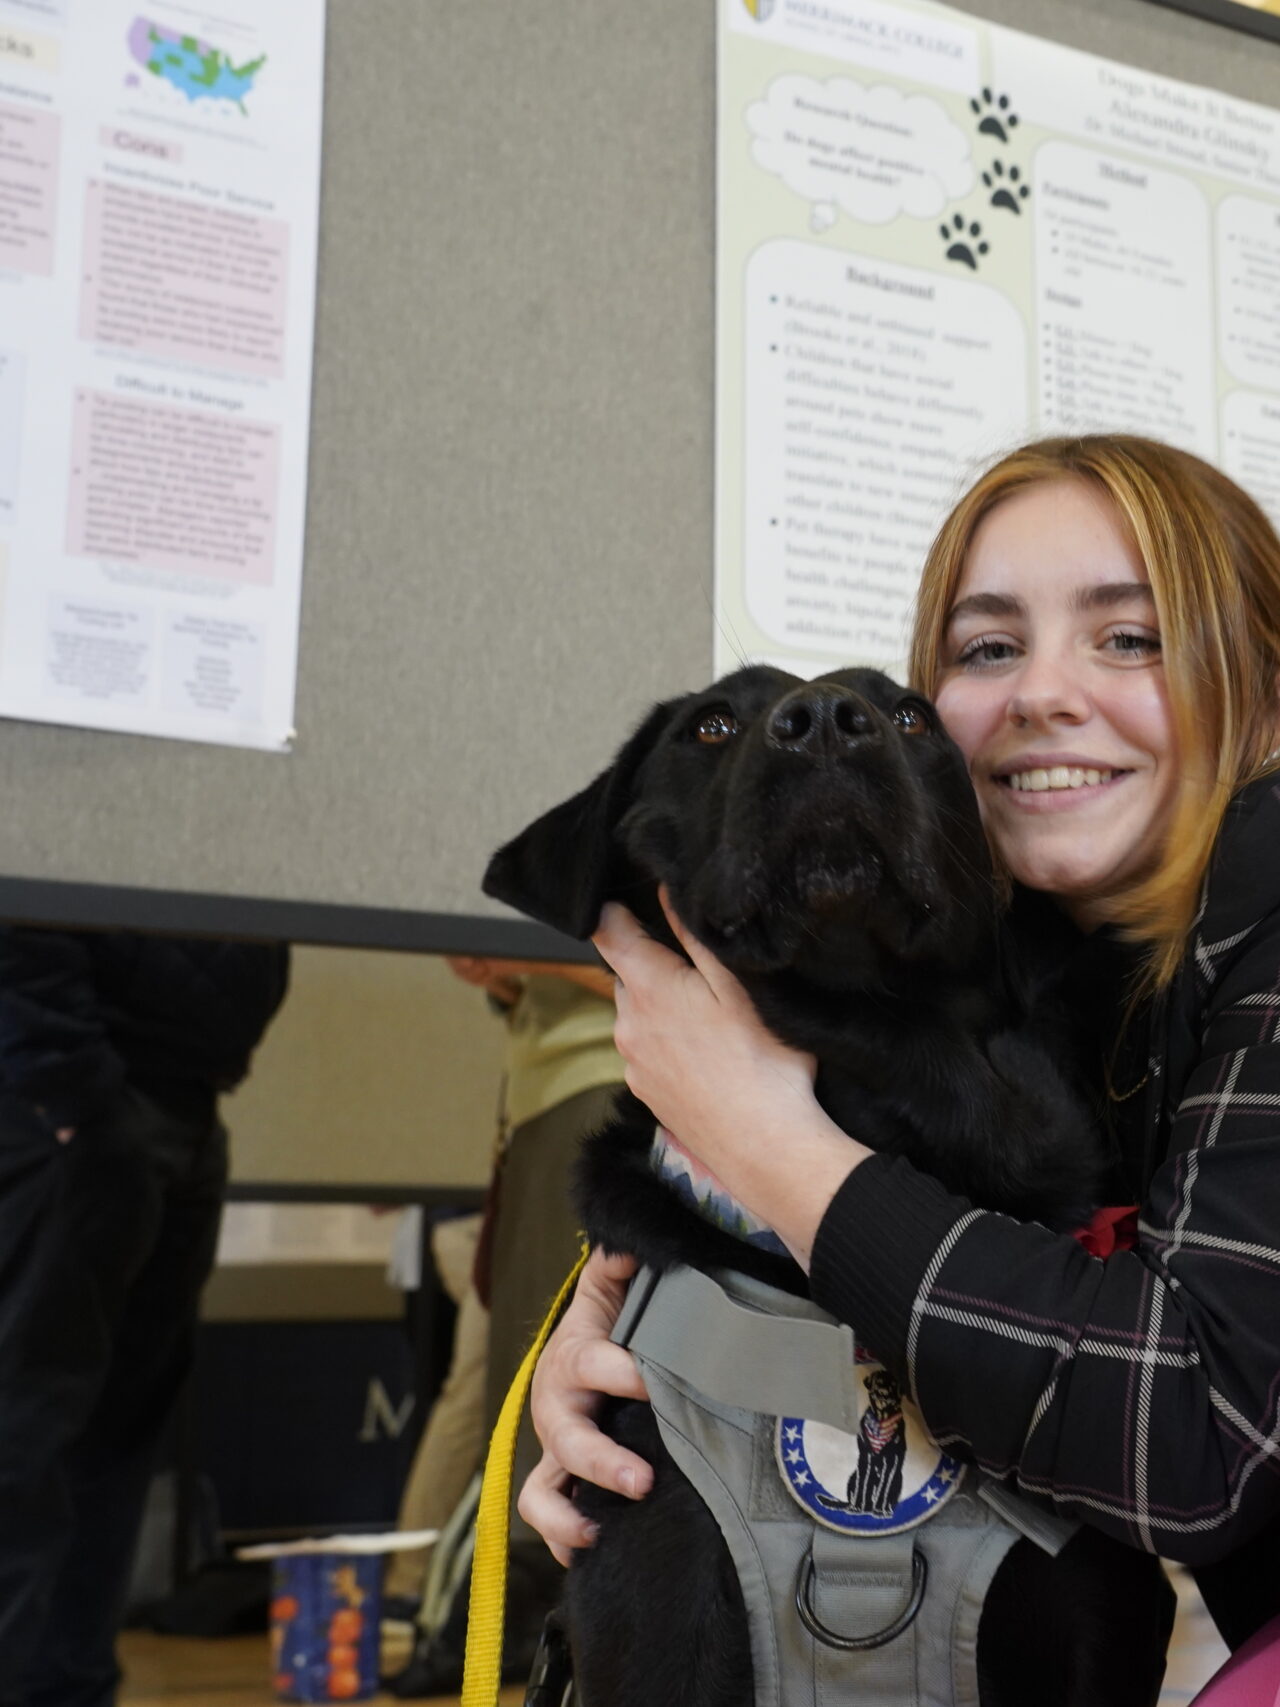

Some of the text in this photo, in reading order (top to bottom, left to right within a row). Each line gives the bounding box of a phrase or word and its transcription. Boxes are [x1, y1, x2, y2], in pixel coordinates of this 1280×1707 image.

[1110, 99, 1200, 140] Alexandra
[114, 131, 167, 157] Cons
[847, 266, 934, 301] Background
[785, 345, 844, 367] Children
[115, 374, 245, 411] Difficult to Manage
